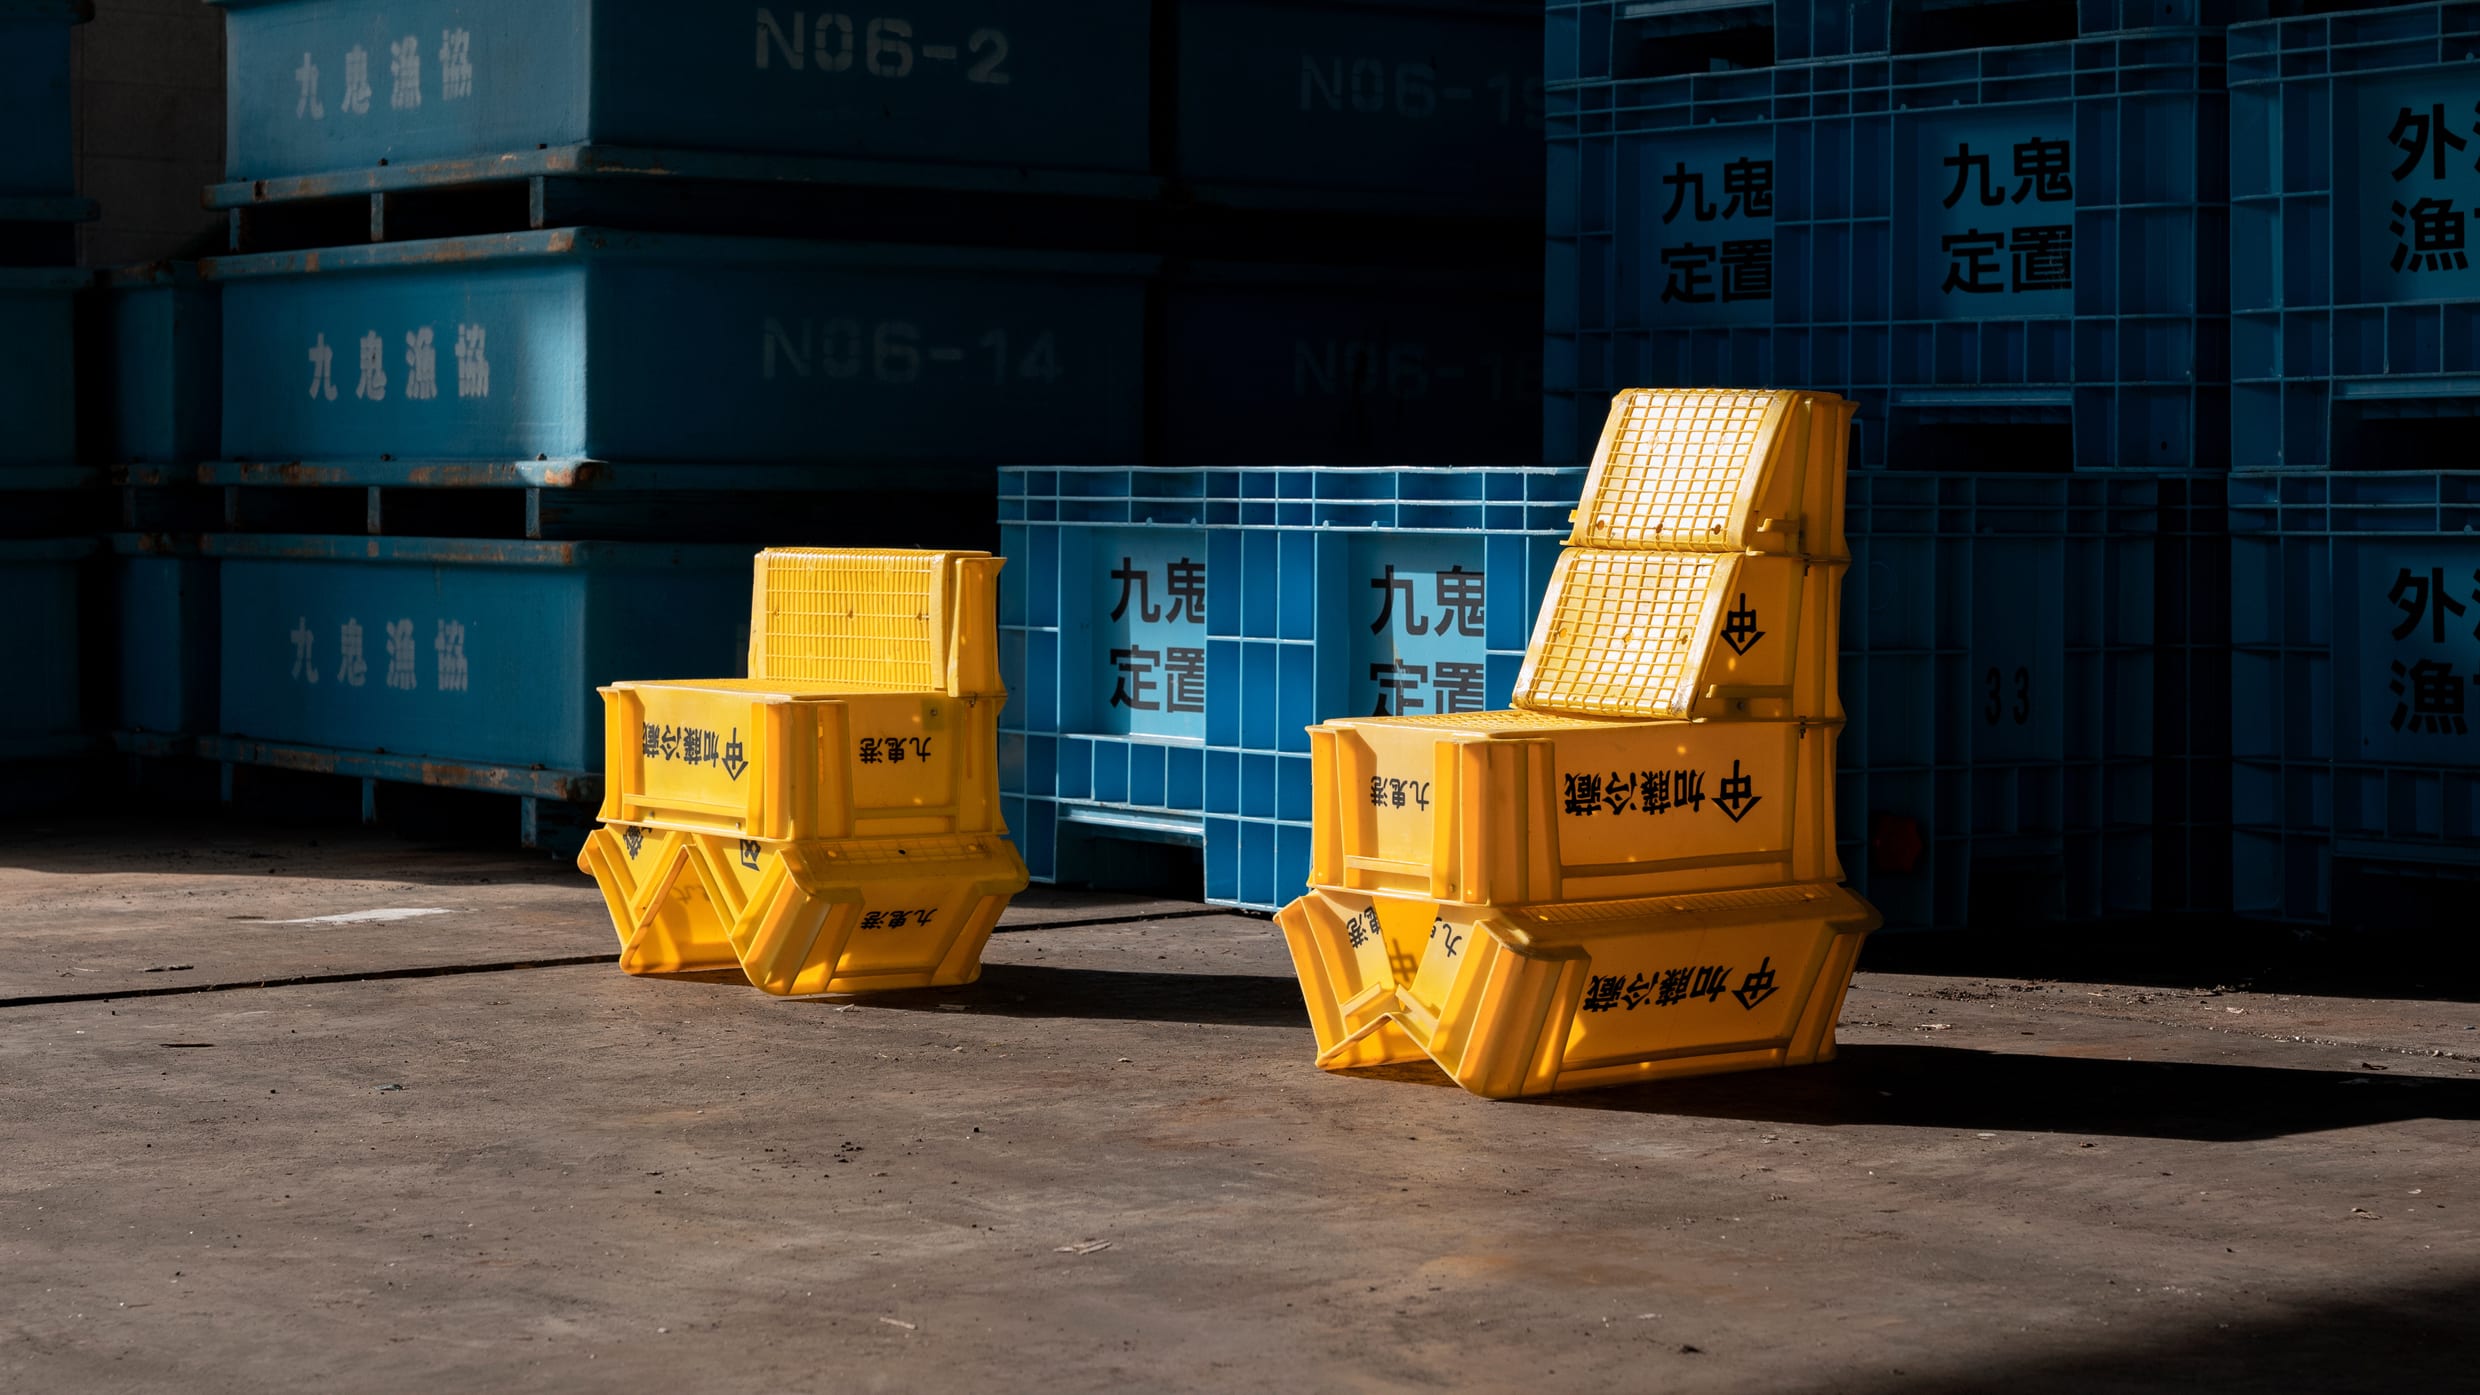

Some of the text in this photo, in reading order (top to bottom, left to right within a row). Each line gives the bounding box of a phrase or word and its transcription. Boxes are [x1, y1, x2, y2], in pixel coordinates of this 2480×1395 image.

[295, 28, 473, 119] 九鬼漁協
[1942, 137, 2072, 210] 九鬼
[2387, 102, 2480, 182] 外
[1661, 156, 1772, 225] 九鬼
[1941, 224, 2072, 296] 定置
[2389, 197, 2480, 273] 漁
[1660, 238, 1772, 305] 定置
[308, 323, 489, 401] 九鬼漁協
[1109, 556, 1206, 624] 九鬼
[1370, 564, 1485, 636] 九鬼
[2387, 567, 2480, 643] 外
[290, 617, 469, 694] 九鬼漁協
[1109, 646, 1206, 713] 定置
[1984, 666, 2030, 726] 33
[2389, 658, 2480, 735] 漁
[860, 736, 932, 764] 九鬼港
